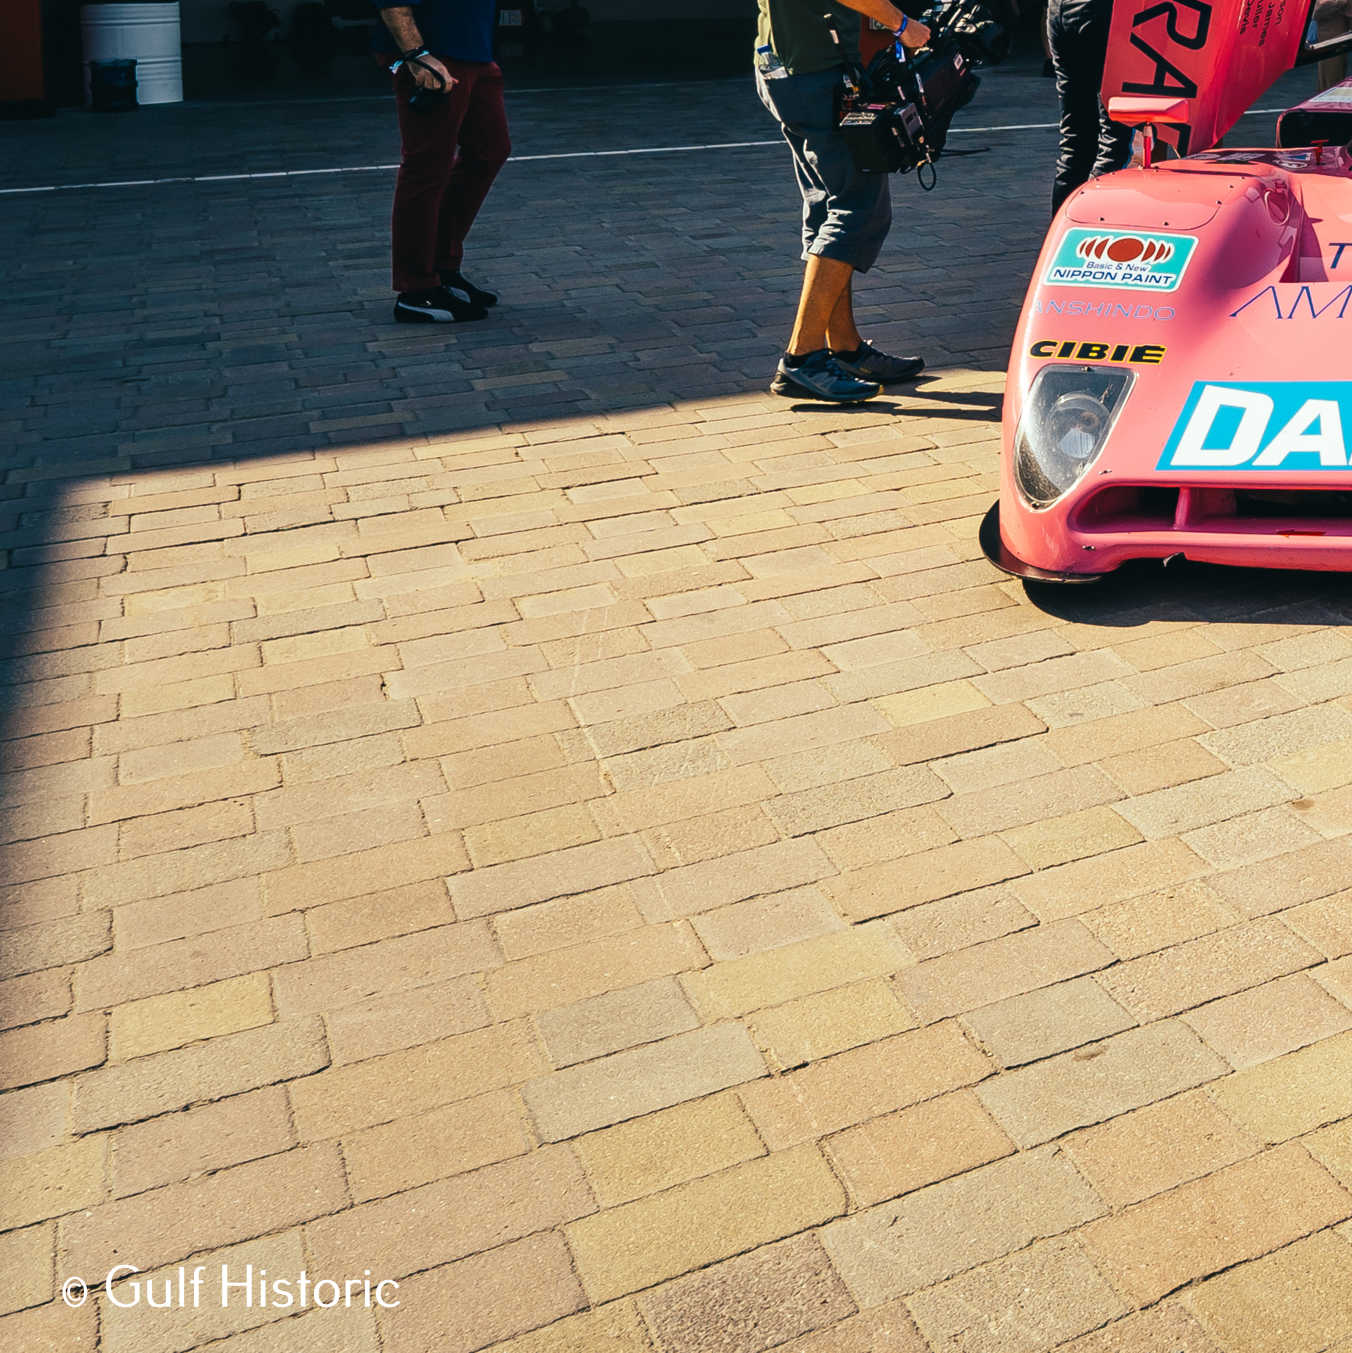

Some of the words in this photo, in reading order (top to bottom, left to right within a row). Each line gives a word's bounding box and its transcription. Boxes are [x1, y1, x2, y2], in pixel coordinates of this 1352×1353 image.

[1086, 261, 1113, 271] Basic
[1115, 262, 1123, 271] &
[1125, 263, 1149, 272] New
[1053, 269, 1118, 281] NIPPON
[1121, 273, 1174, 285] PAINT
